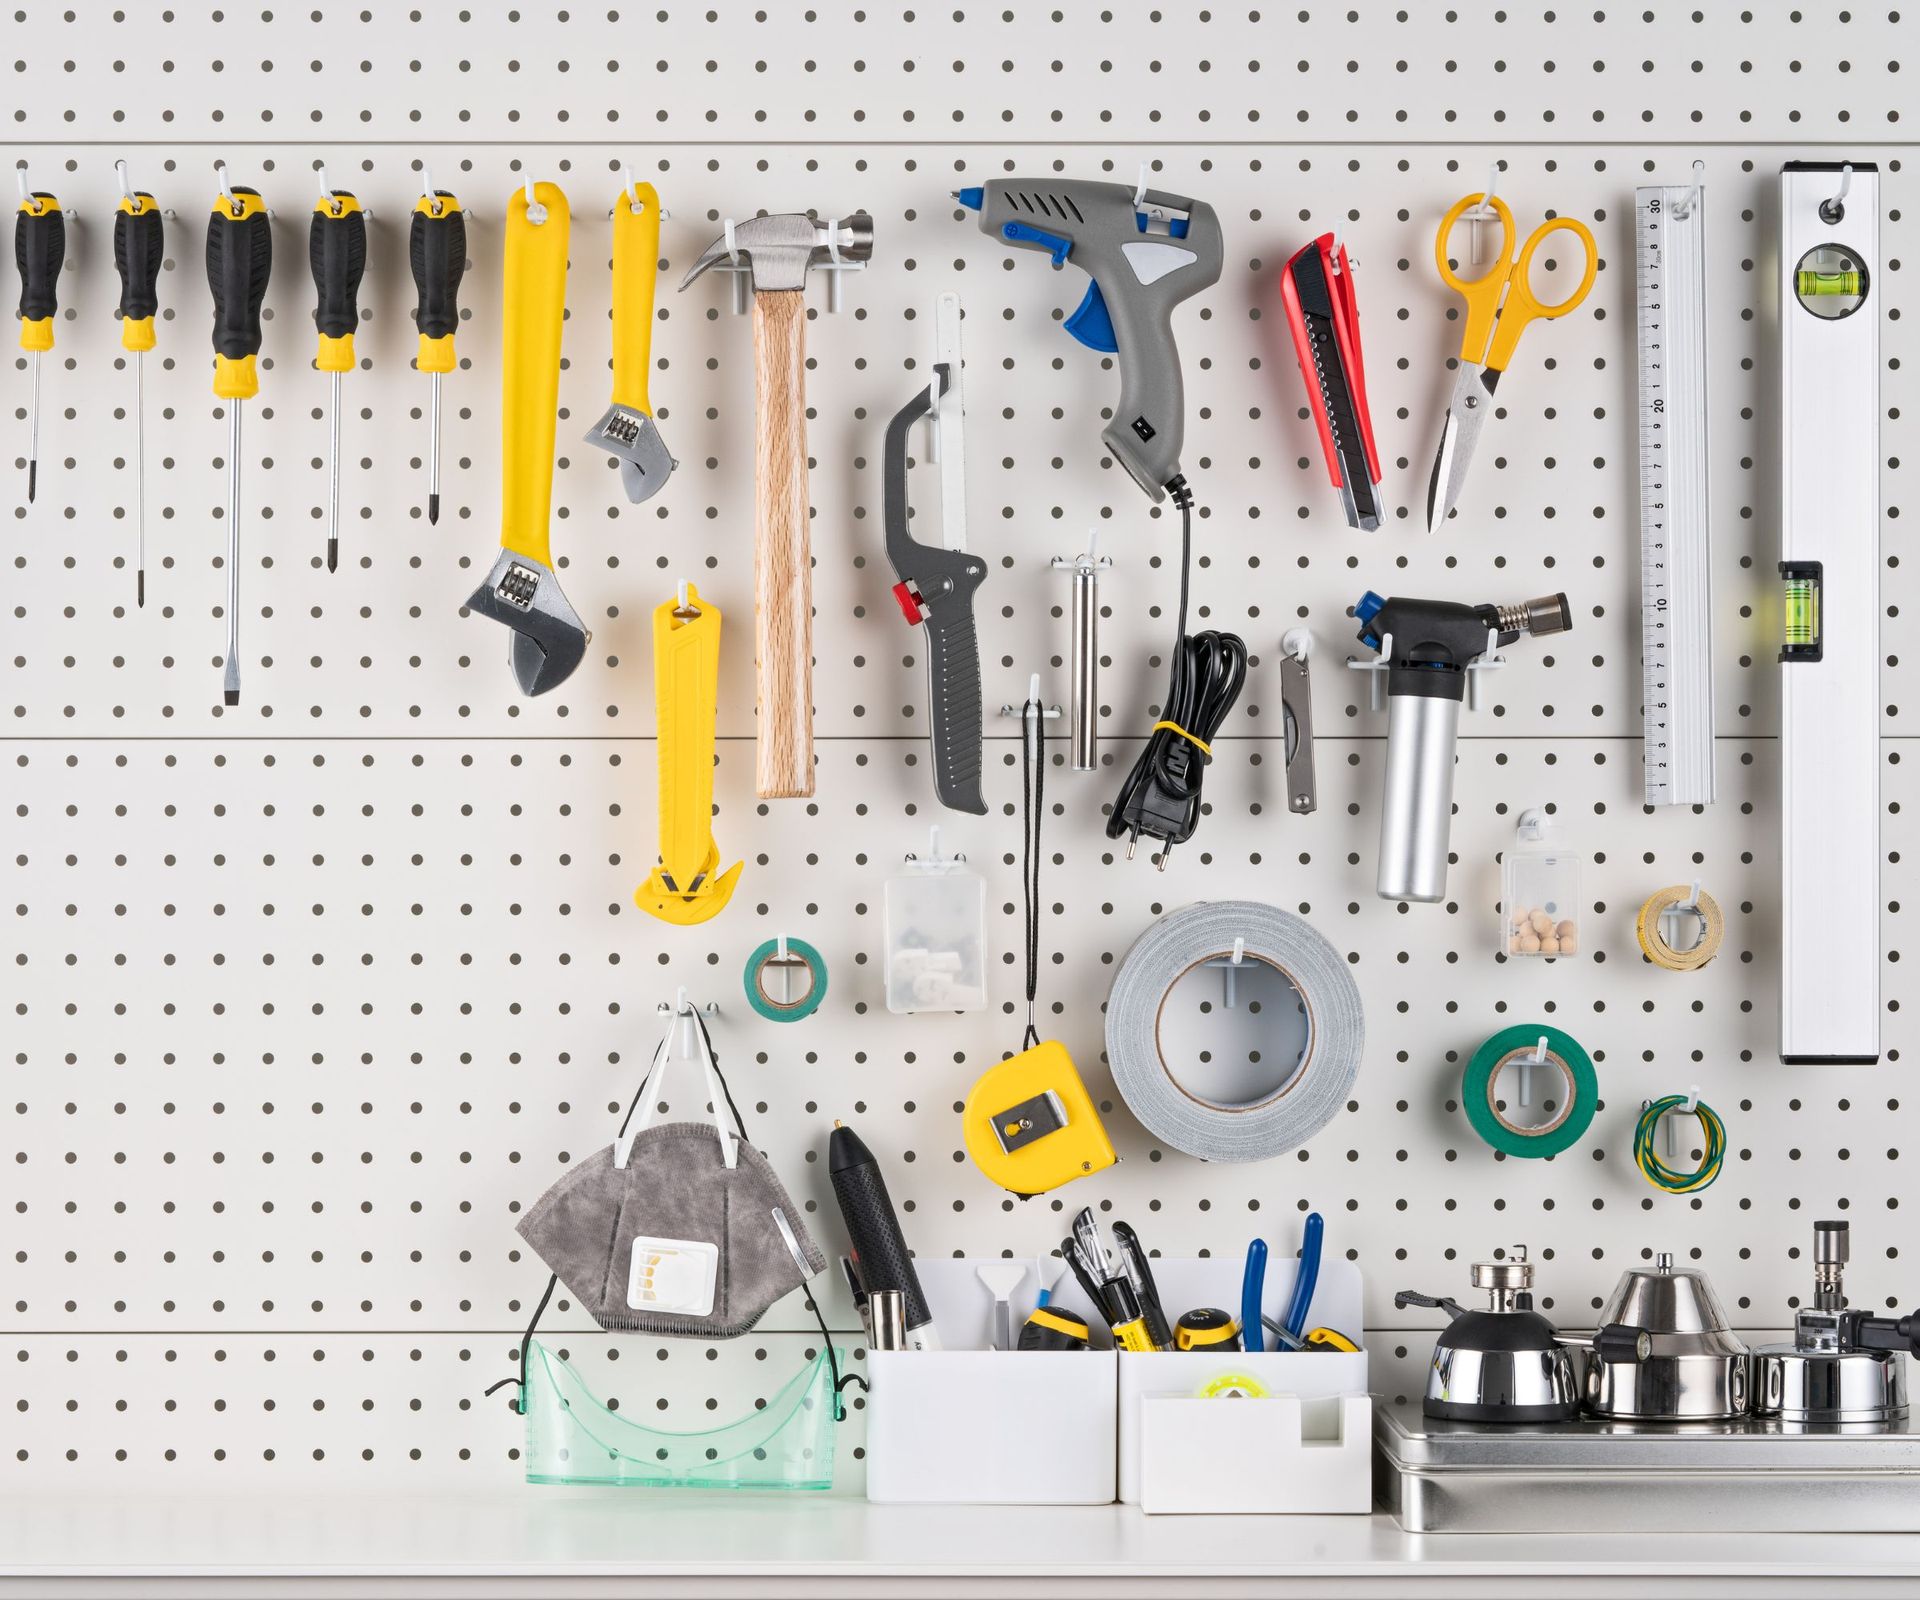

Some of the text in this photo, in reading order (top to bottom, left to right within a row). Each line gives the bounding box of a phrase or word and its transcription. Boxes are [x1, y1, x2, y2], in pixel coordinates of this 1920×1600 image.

[1649, 199, 1661, 214] 30
[1653, 398, 1664, 414] 20
[1656, 598, 1668, 613] 10
